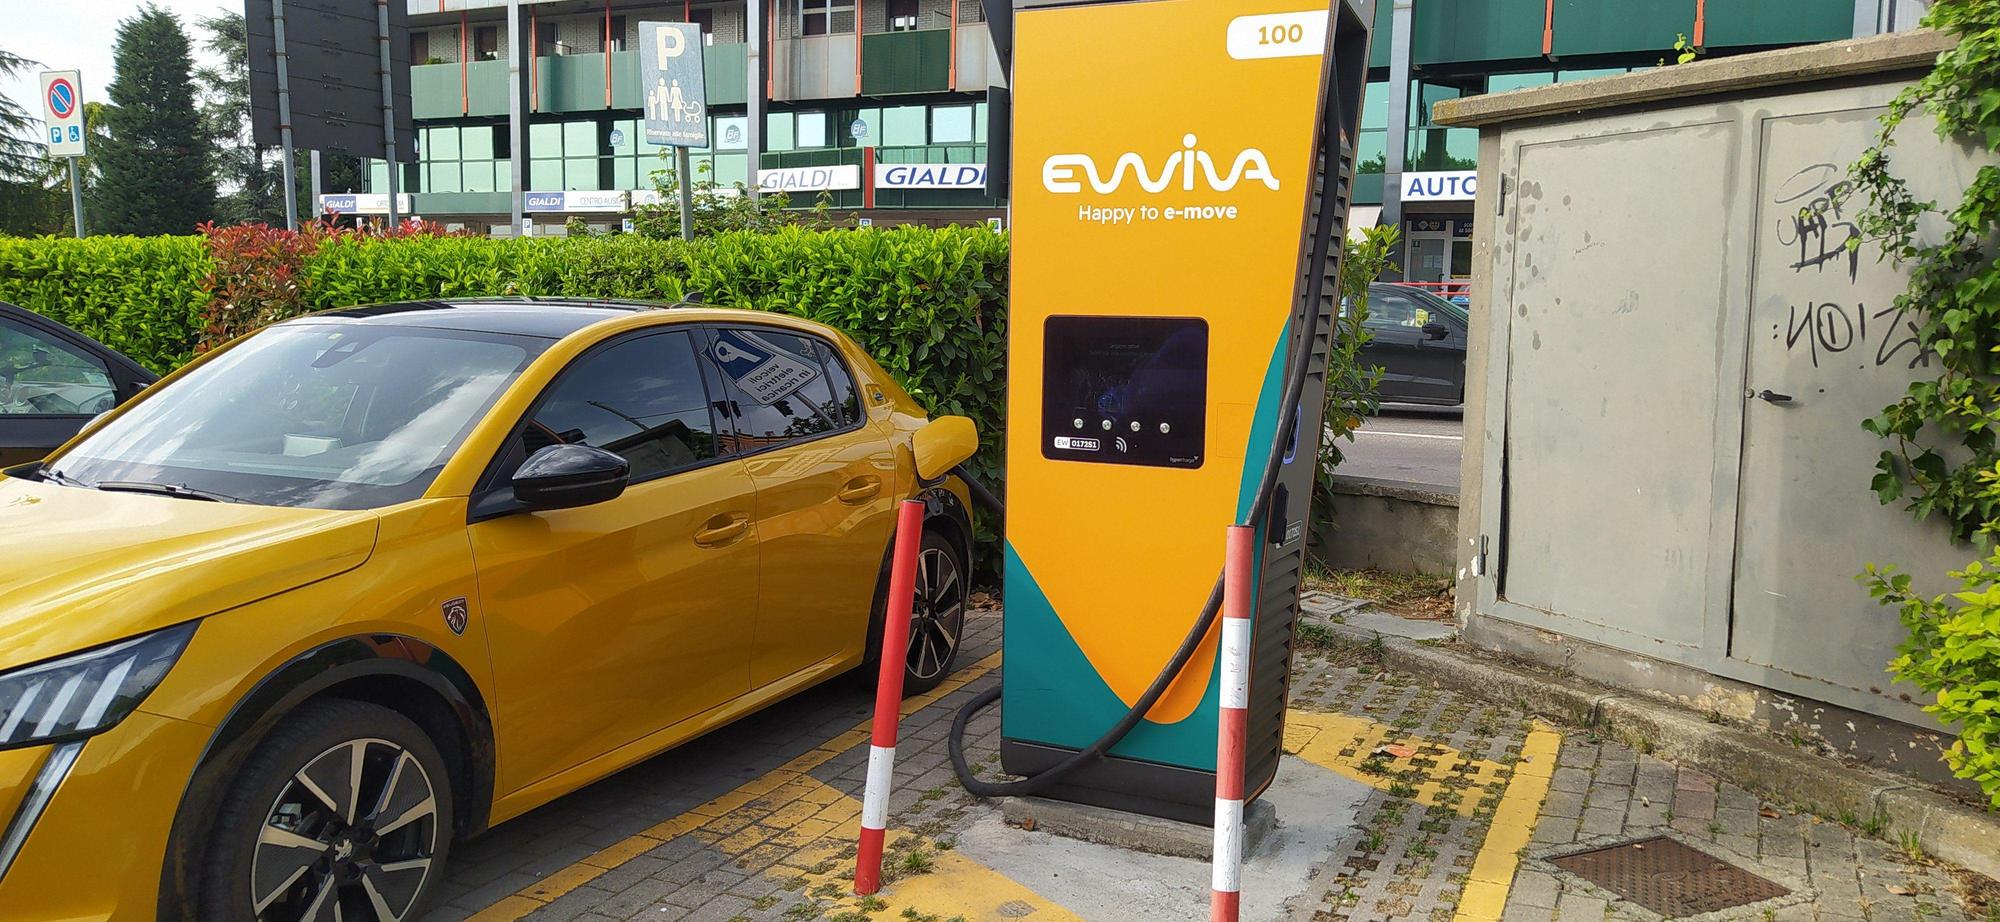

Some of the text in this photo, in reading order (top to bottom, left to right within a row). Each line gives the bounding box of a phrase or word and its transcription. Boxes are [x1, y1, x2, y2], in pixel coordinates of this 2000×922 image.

[1258, 24, 1304, 45] 100
[656, 26, 685, 71] P
[763, 169, 834, 189] GIALDI
[326, 200, 355, 209] GIALDI
[528, 197, 562, 206] GIALDI
[1078, 204, 1238, 224] Happy to e-move
